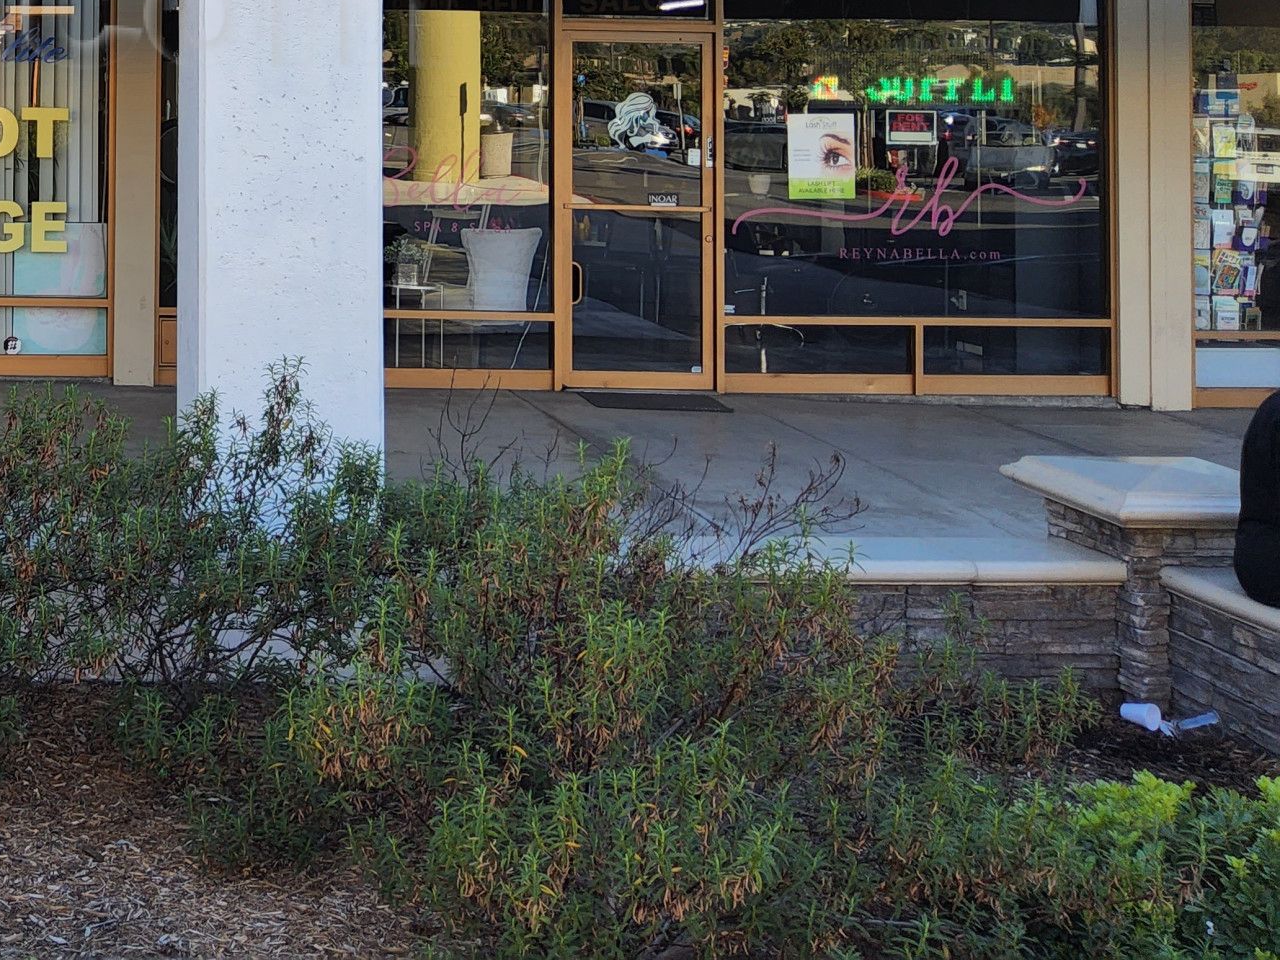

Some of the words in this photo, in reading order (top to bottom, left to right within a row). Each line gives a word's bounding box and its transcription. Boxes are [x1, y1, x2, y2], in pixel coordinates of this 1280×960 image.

[896, 113, 925, 121] FOR
[892, 122, 930, 131] RENT
[649, 194, 678, 203] INOAR
[839, 247, 1001, 260] REYNABELLA.com
